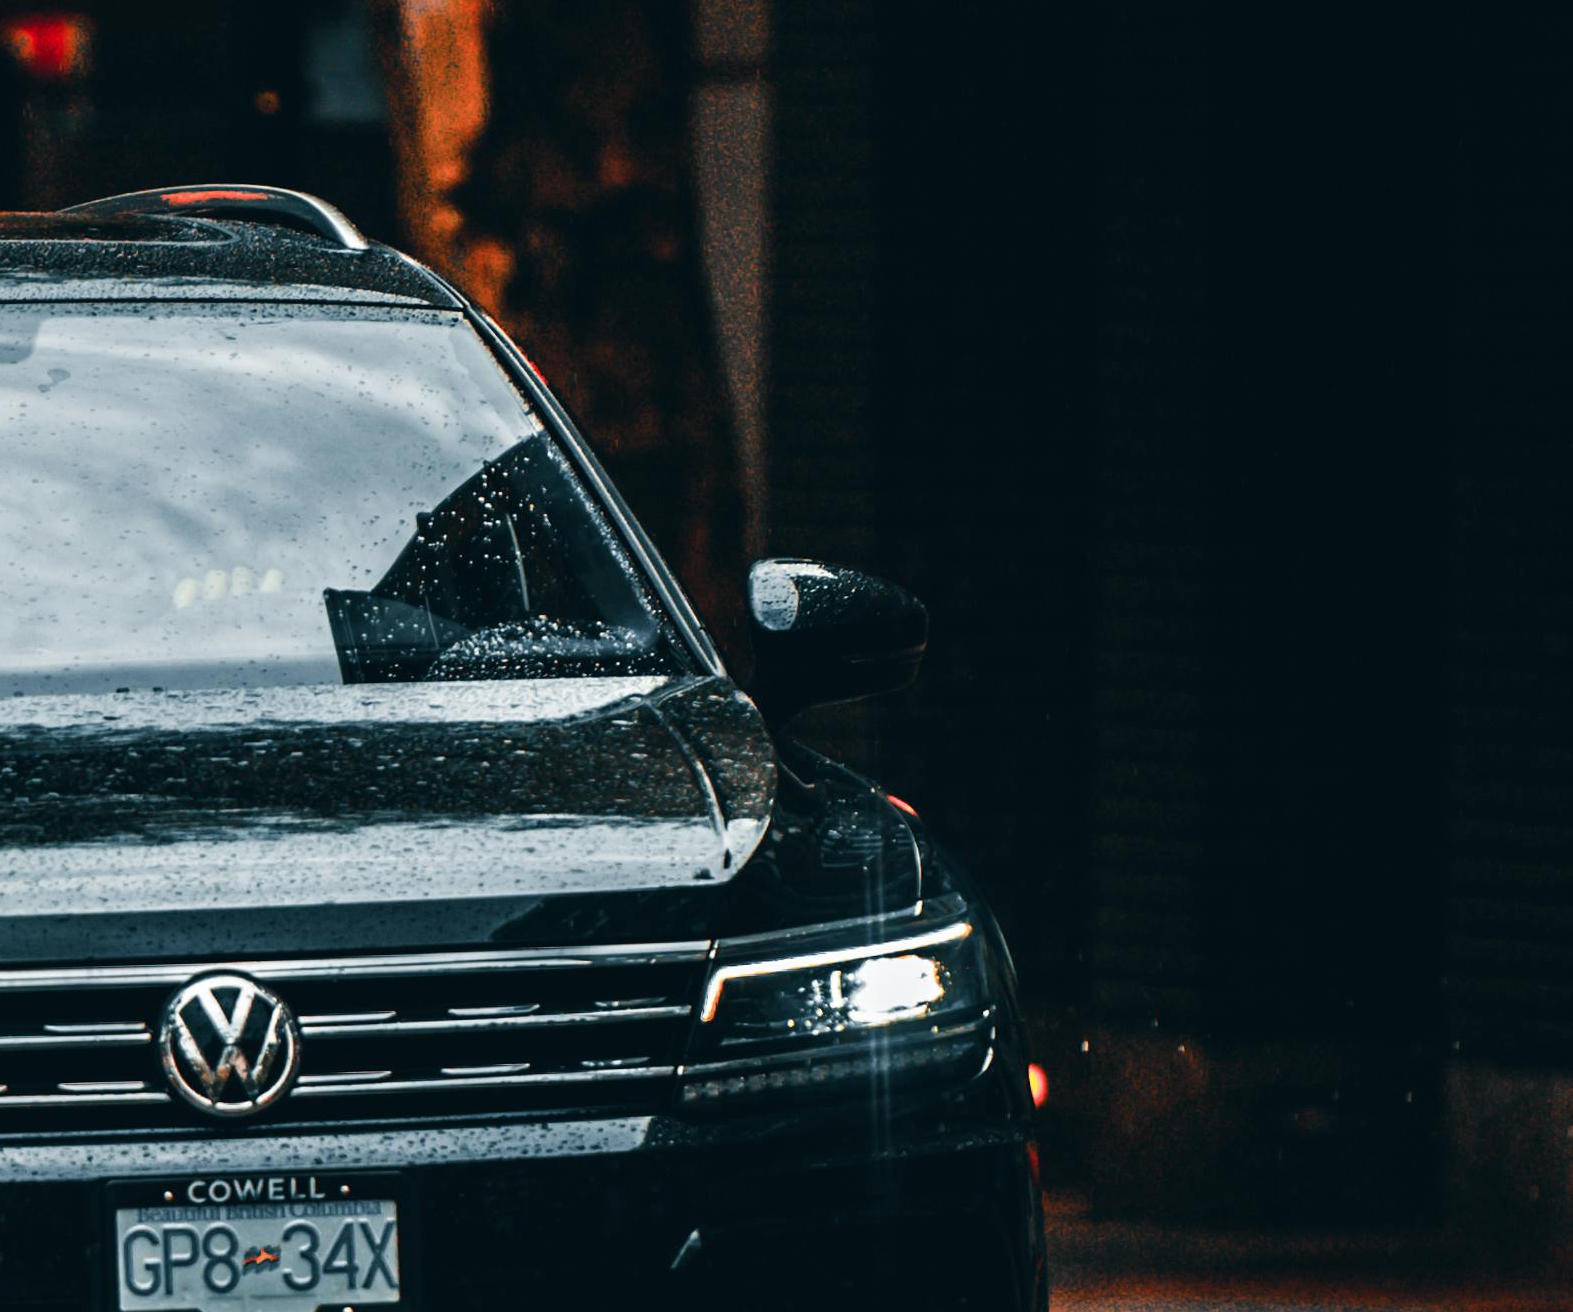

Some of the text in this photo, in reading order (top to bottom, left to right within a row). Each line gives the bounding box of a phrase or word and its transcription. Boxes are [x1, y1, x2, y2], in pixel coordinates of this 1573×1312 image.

[187, 1177, 326, 1203] COWELL
[287, 1199, 382, 1217] Columbia
[123, 1217, 399, 1297] GP8 34X
